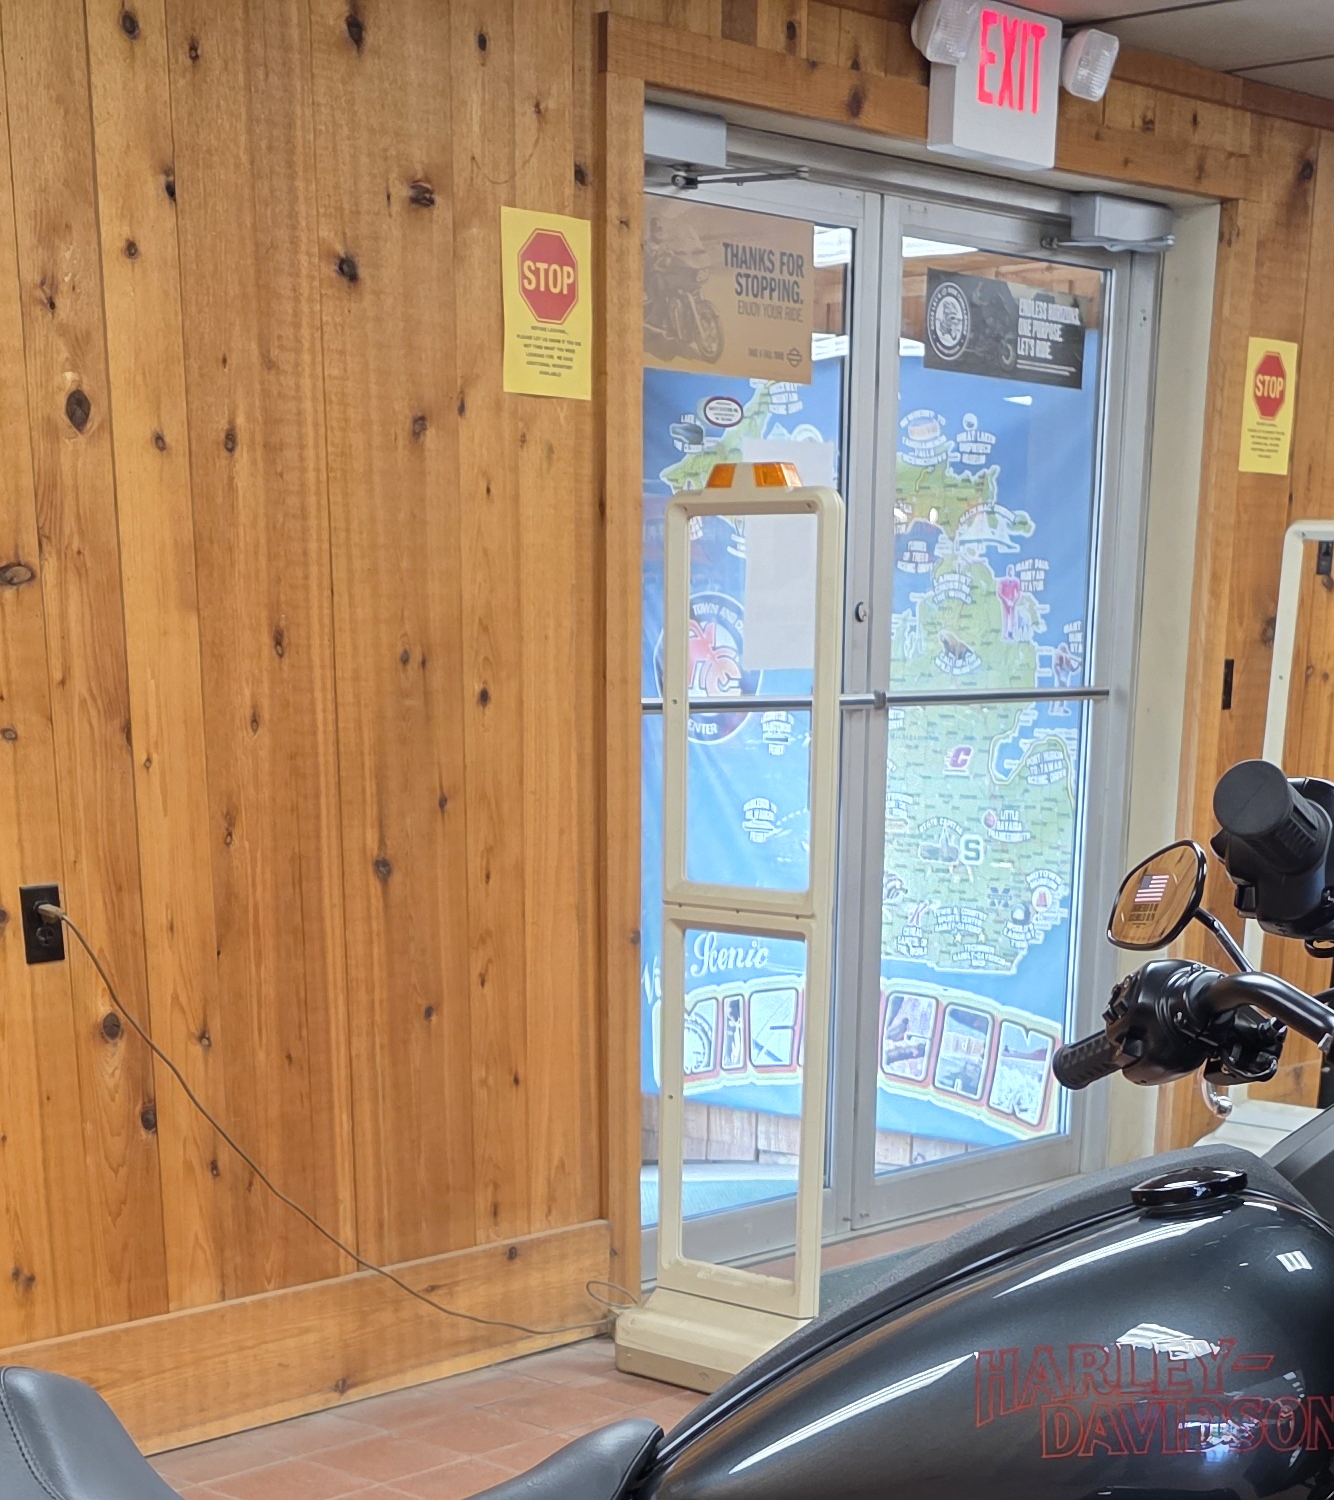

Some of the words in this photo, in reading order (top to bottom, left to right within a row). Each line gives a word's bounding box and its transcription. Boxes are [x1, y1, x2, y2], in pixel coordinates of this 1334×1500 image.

[977, 8, 1047, 115] EXIT
[722, 242, 775, 274] THANKS
[779, 251, 805, 279] FOR
[523, 260, 575, 295] STOP
[735, 272, 804, 305] STOPPING.
[737, 300, 761, 317] ENJOY
[763, 303, 783, 321] YOUR
[1255, 374, 1284, 399] STOP
[692, 602, 720, 616] TOWN
[719, 606, 738, 624] AND
[688, 719, 718, 735] ENTER
[964, 840, 980, 861] S
[690, 931, 769, 977] Scenic
[975, 1337, 1274, 1427] HARLEY-
